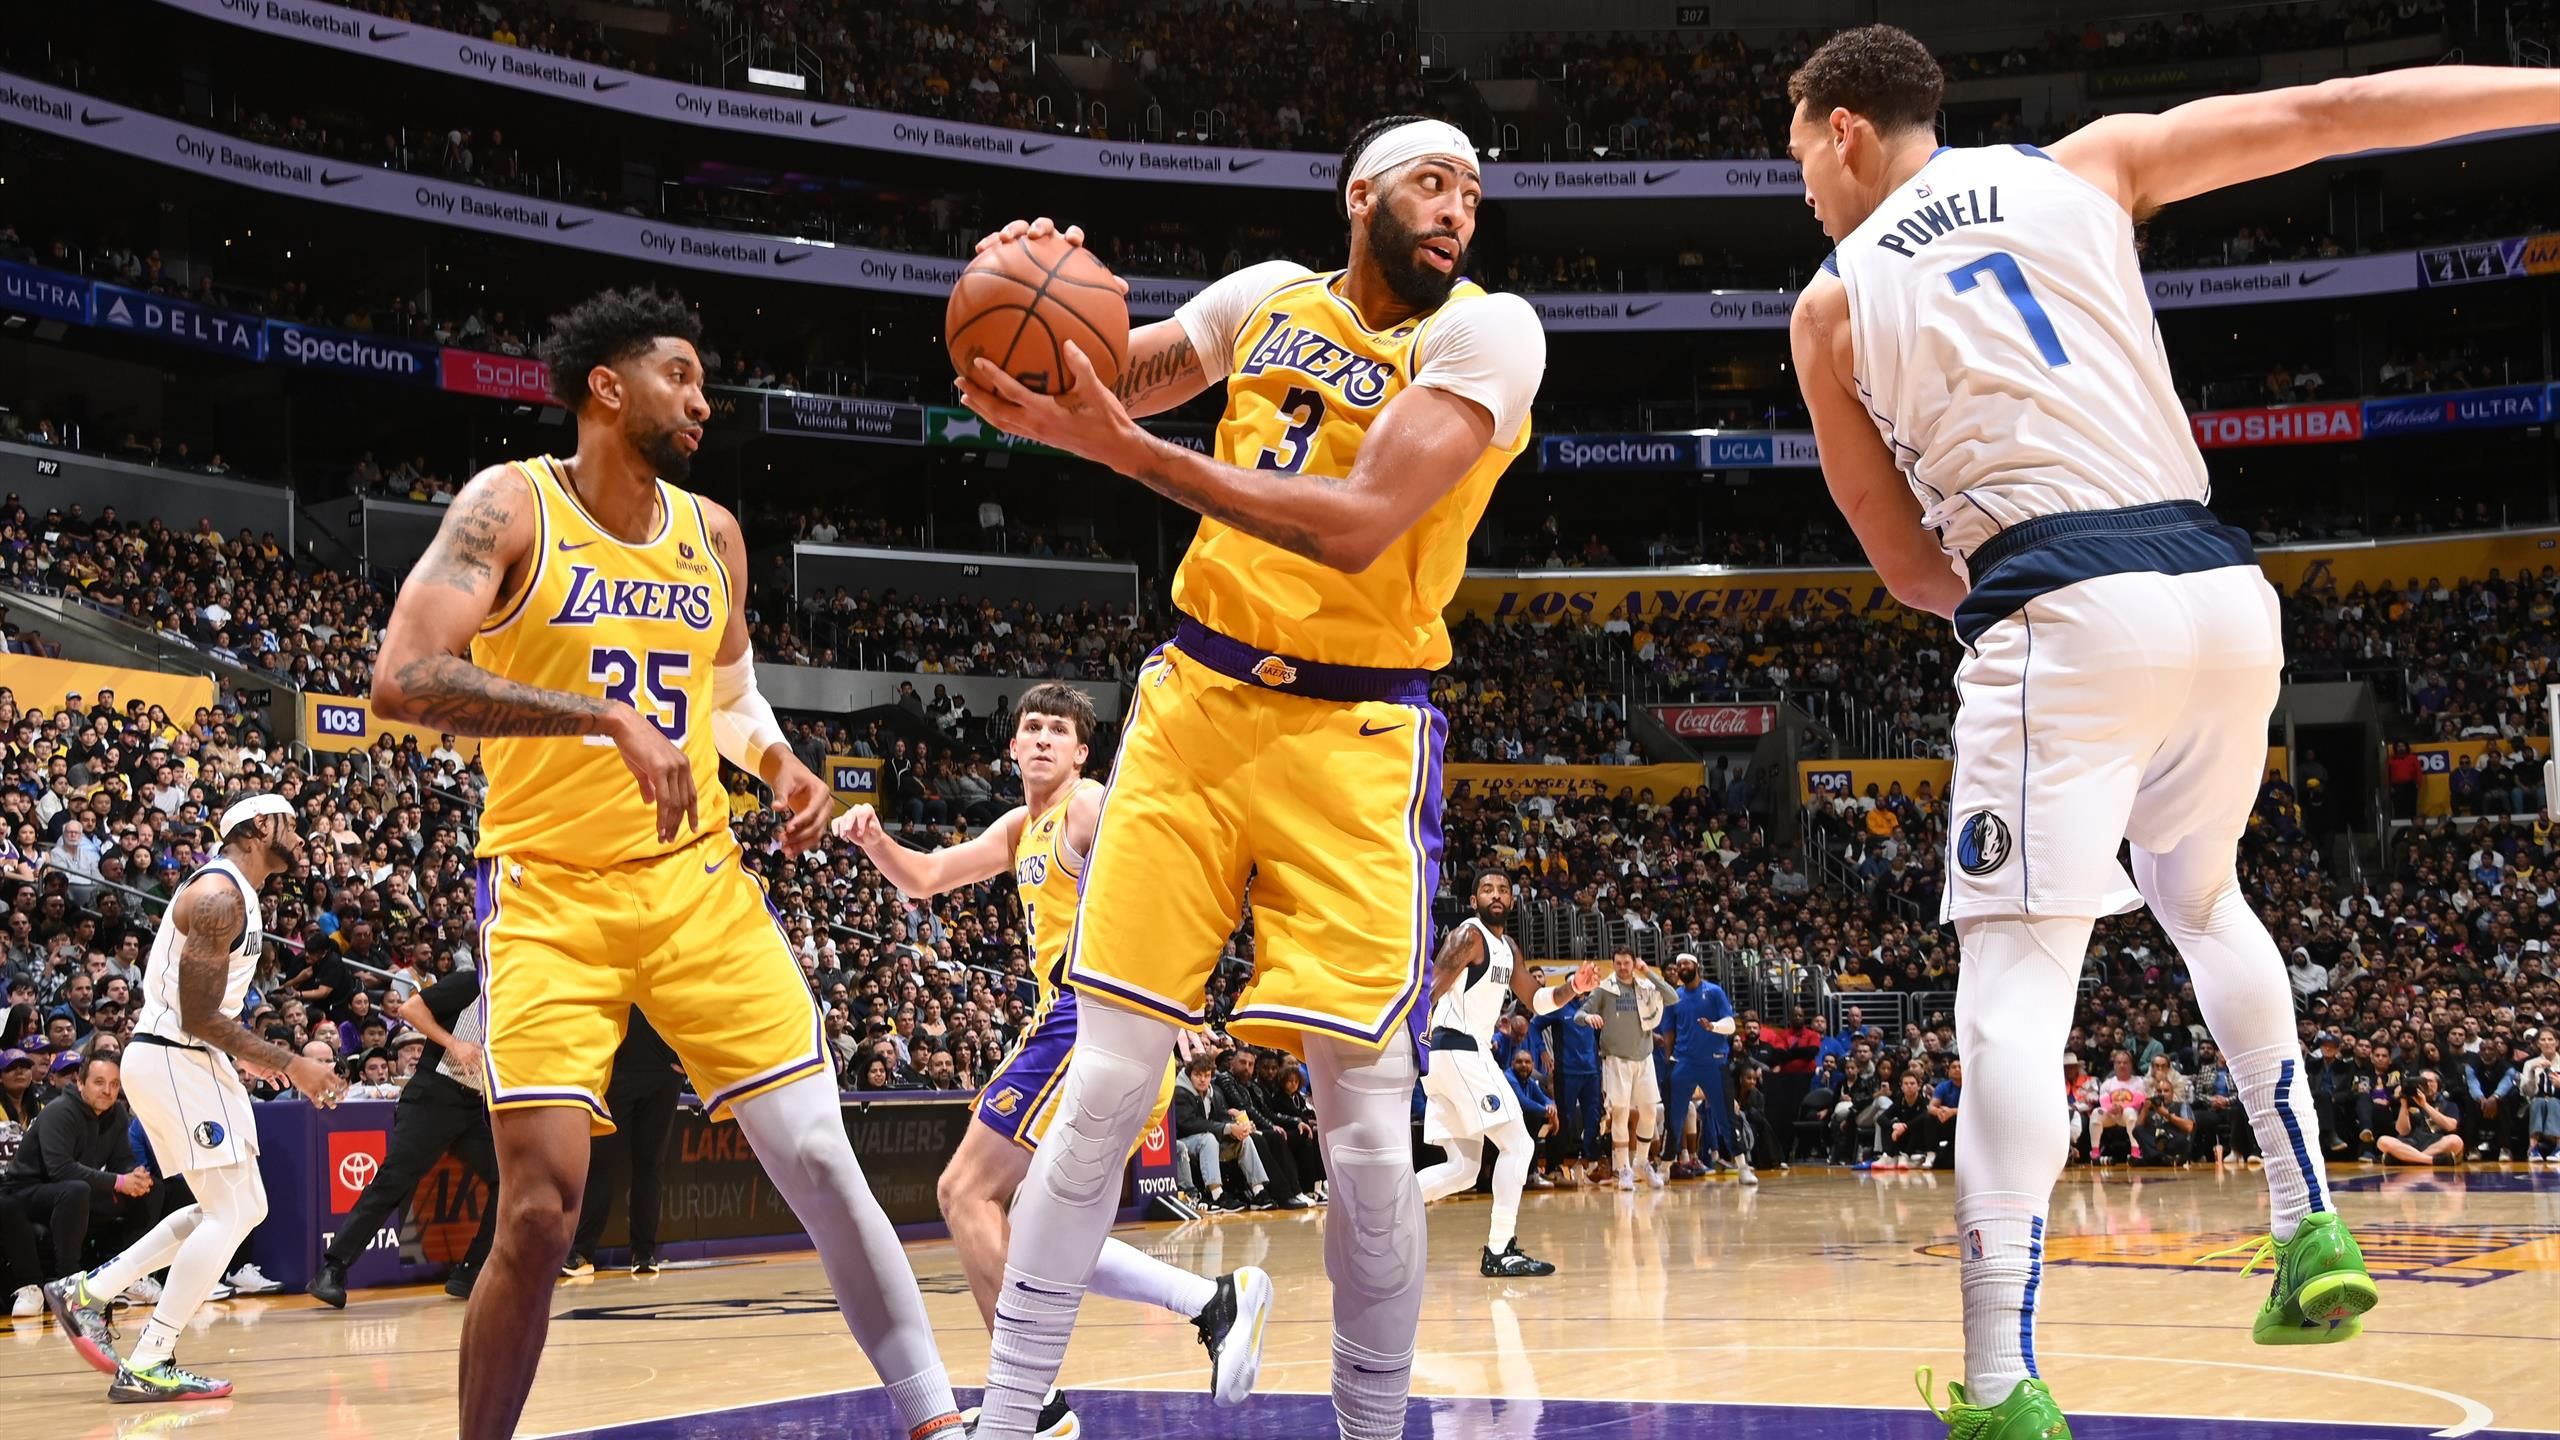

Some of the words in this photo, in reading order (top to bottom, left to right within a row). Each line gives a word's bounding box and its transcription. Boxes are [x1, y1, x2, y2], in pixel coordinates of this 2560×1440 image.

[266, 1, 361, 39] Basketball
[1681, 9, 1705, 23] 307
[458, 46, 497, 72] Only
[502, 55, 586, 89] Basketball
[0, 86, 73, 122] sketball
[675, 93, 712, 117] Only
[718, 101, 803, 126] Basketball
[894, 123, 929, 145] Only
[934, 129, 1013, 154] Basketball
[176, 134, 214, 164] Only
[220, 146, 312, 184] Basketball
[1098, 150, 1135, 171] Only
[1140, 153, 1221, 172] Basketball
[1513, 170, 1549, 191] Only
[1554, 170, 1637, 187] Basketball
[1725, 169, 1762, 187] Only
[414, 186, 456, 212] Only
[460, 196, 549, 228] Basketball
[1877, 185, 2005, 258] POWELL
[640, 229, 676, 256] Only
[681, 237, 767, 265] Basketball
[860, 258, 898, 281] Only
[902, 264, 962, 286] Basket
[2440, 261, 2454, 281] 4
[2477, 257, 2492, 276] 4
[7, 275, 81, 311] ULTRA
[2154, 281, 2194, 300] Only
[2200, 273, 2291, 294] Basketball
[1535, 303, 1619, 320] Basketball
[1710, 302, 1746, 320] Only
[1943, 251, 2072, 370] 7
[145, 303, 251, 350] DELTA
[283, 328, 414, 375] Spectrum
[1239, 311, 1398, 409] LAKERS
[791, 397, 833, 412] Happy
[841, 400, 896, 419] Birthday
[2460, 396, 2534, 419] ULTRA
[795, 412, 848, 430] Yulonda
[856, 415, 892, 433] Howe
[1254, 384, 1328, 474] 3
[2199, 410, 2353, 443] TOSHIBA
[1559, 440, 1676, 468] Spectrum
[1718, 443, 1766, 460] UCLA
[1780, 442, 1820, 461] Hea
[38, 460, 58, 475] PR7
[676, 558, 709, 575] bibigo
[963, 565, 980, 577] PR9
[548, 564, 714, 632] LAKERS
[1492, 590, 1600, 618] LOS
[1607, 585, 1854, 617] ANGELES
[585, 647, 692, 746] 35
[322, 708, 361, 733] 103
[1675, 708, 1749, 734] Coca-Cola
[2417, 753, 2446, 771] 06
[838, 770, 873, 789] 104
[1482, 778, 1514, 789] LOS
[1811, 773, 1849, 790] 106
[680, 1126, 753, 1164] LAKE
[850, 1119, 947, 1155] VALIERS
[1138, 1177, 1178, 1194] TOYOTA
[322, 1228, 400, 1250] TTA
